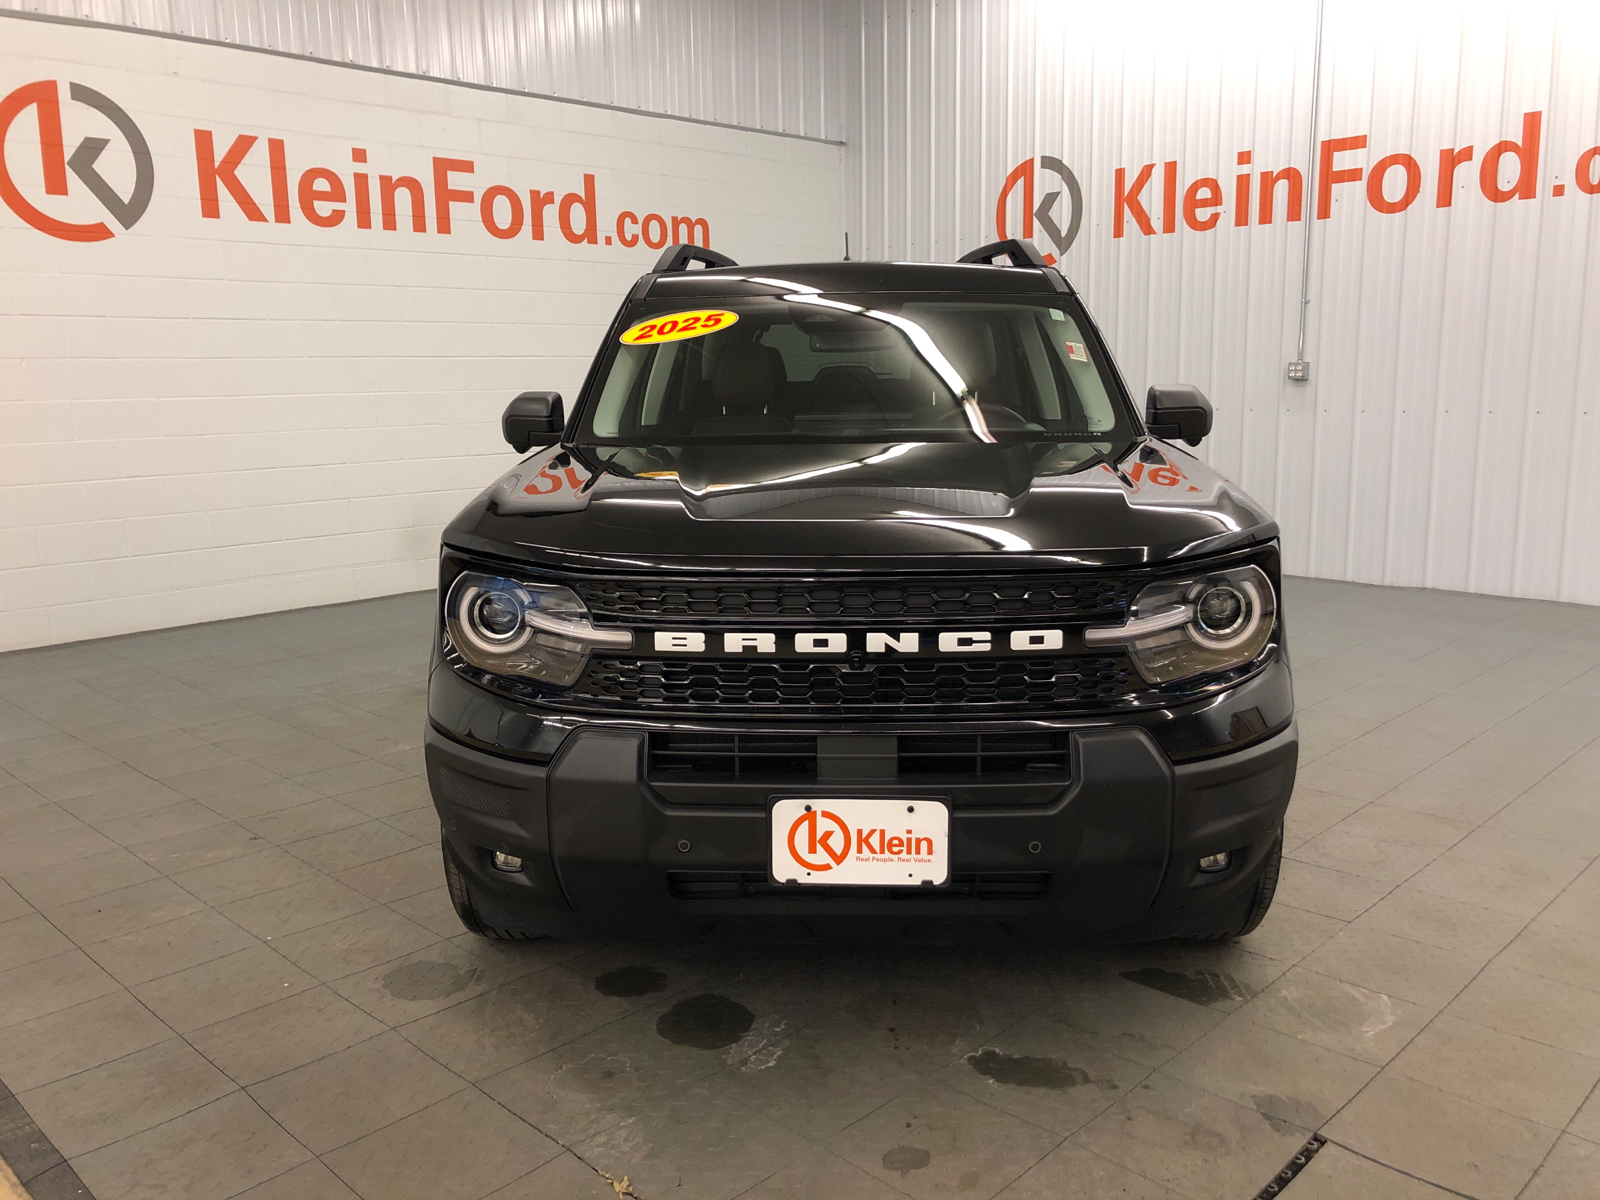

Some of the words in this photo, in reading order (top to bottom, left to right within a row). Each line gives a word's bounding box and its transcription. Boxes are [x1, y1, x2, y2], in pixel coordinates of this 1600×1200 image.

[193, 128, 710, 250] KleinFord.com
[632, 312, 726, 342] 2025
[653, 629, 1064, 654] BRONCO
[856, 828, 934, 856] Klein
[871, 856, 896, 864] People.
